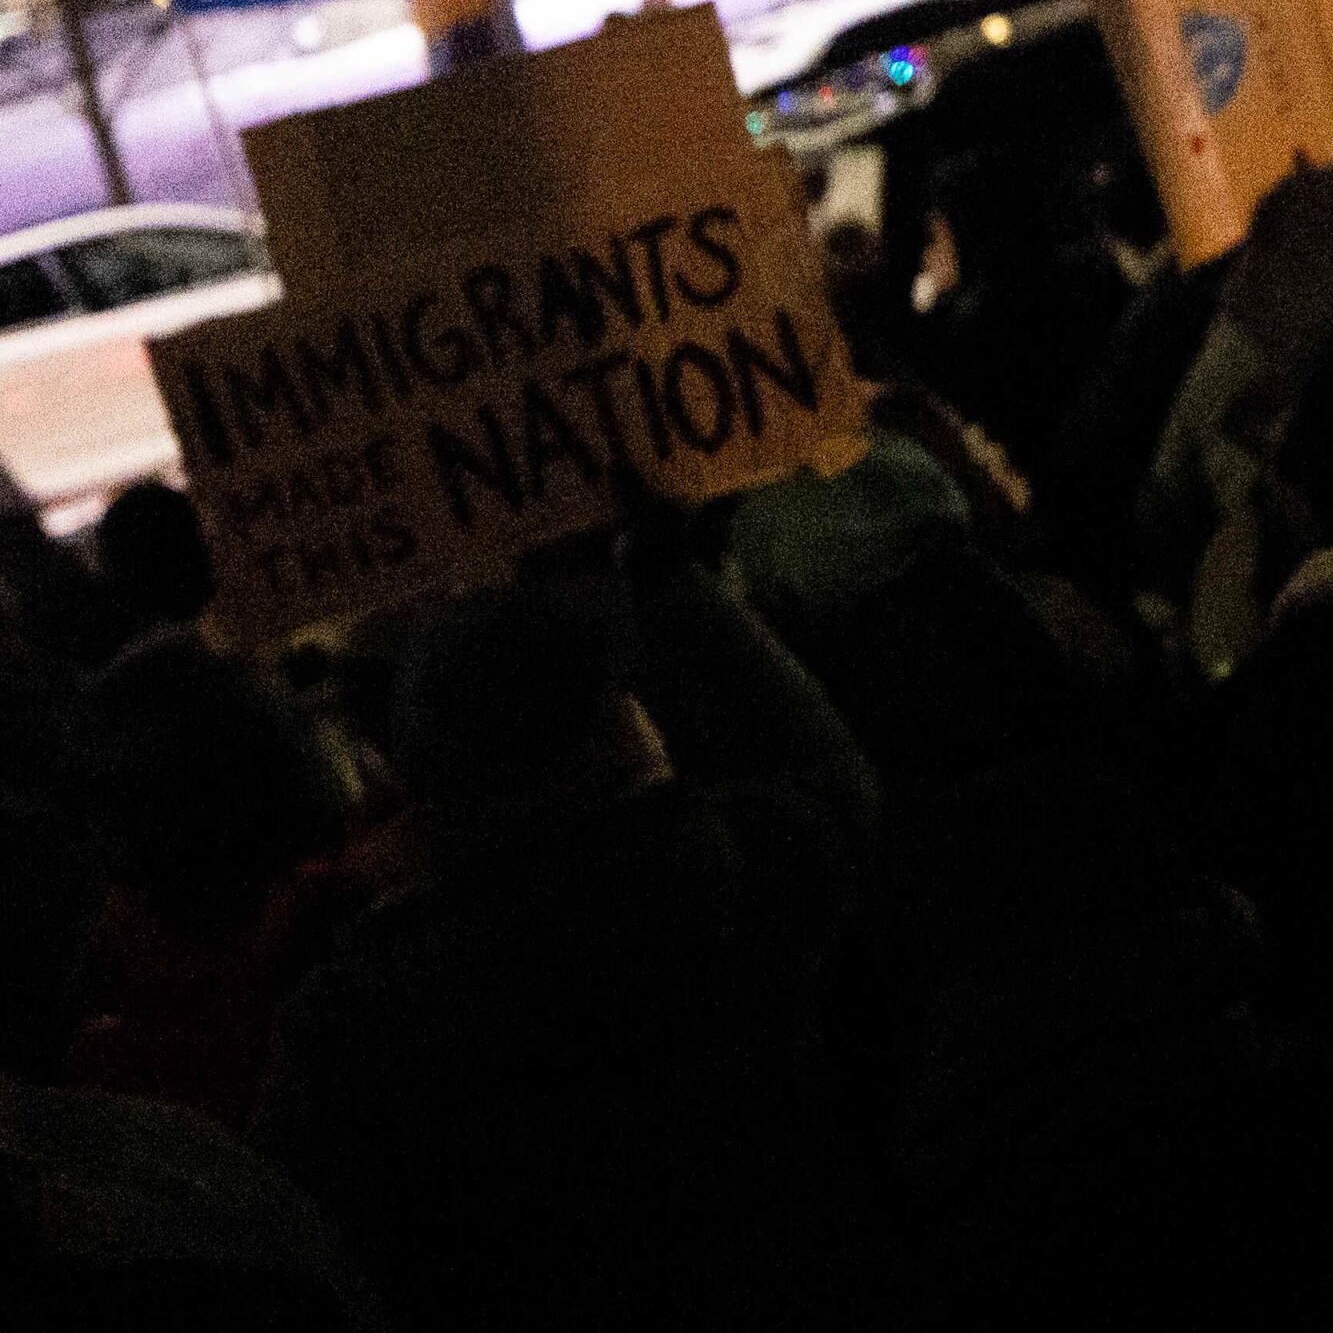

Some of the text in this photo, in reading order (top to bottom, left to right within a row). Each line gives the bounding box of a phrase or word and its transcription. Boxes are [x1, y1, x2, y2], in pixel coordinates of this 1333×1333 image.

[182, 206, 740, 466] IMMIGRANTS
[226, 435, 400, 527] MADE
[427, 310, 819, 530] NATION
[250, 505, 417, 589] THIS
